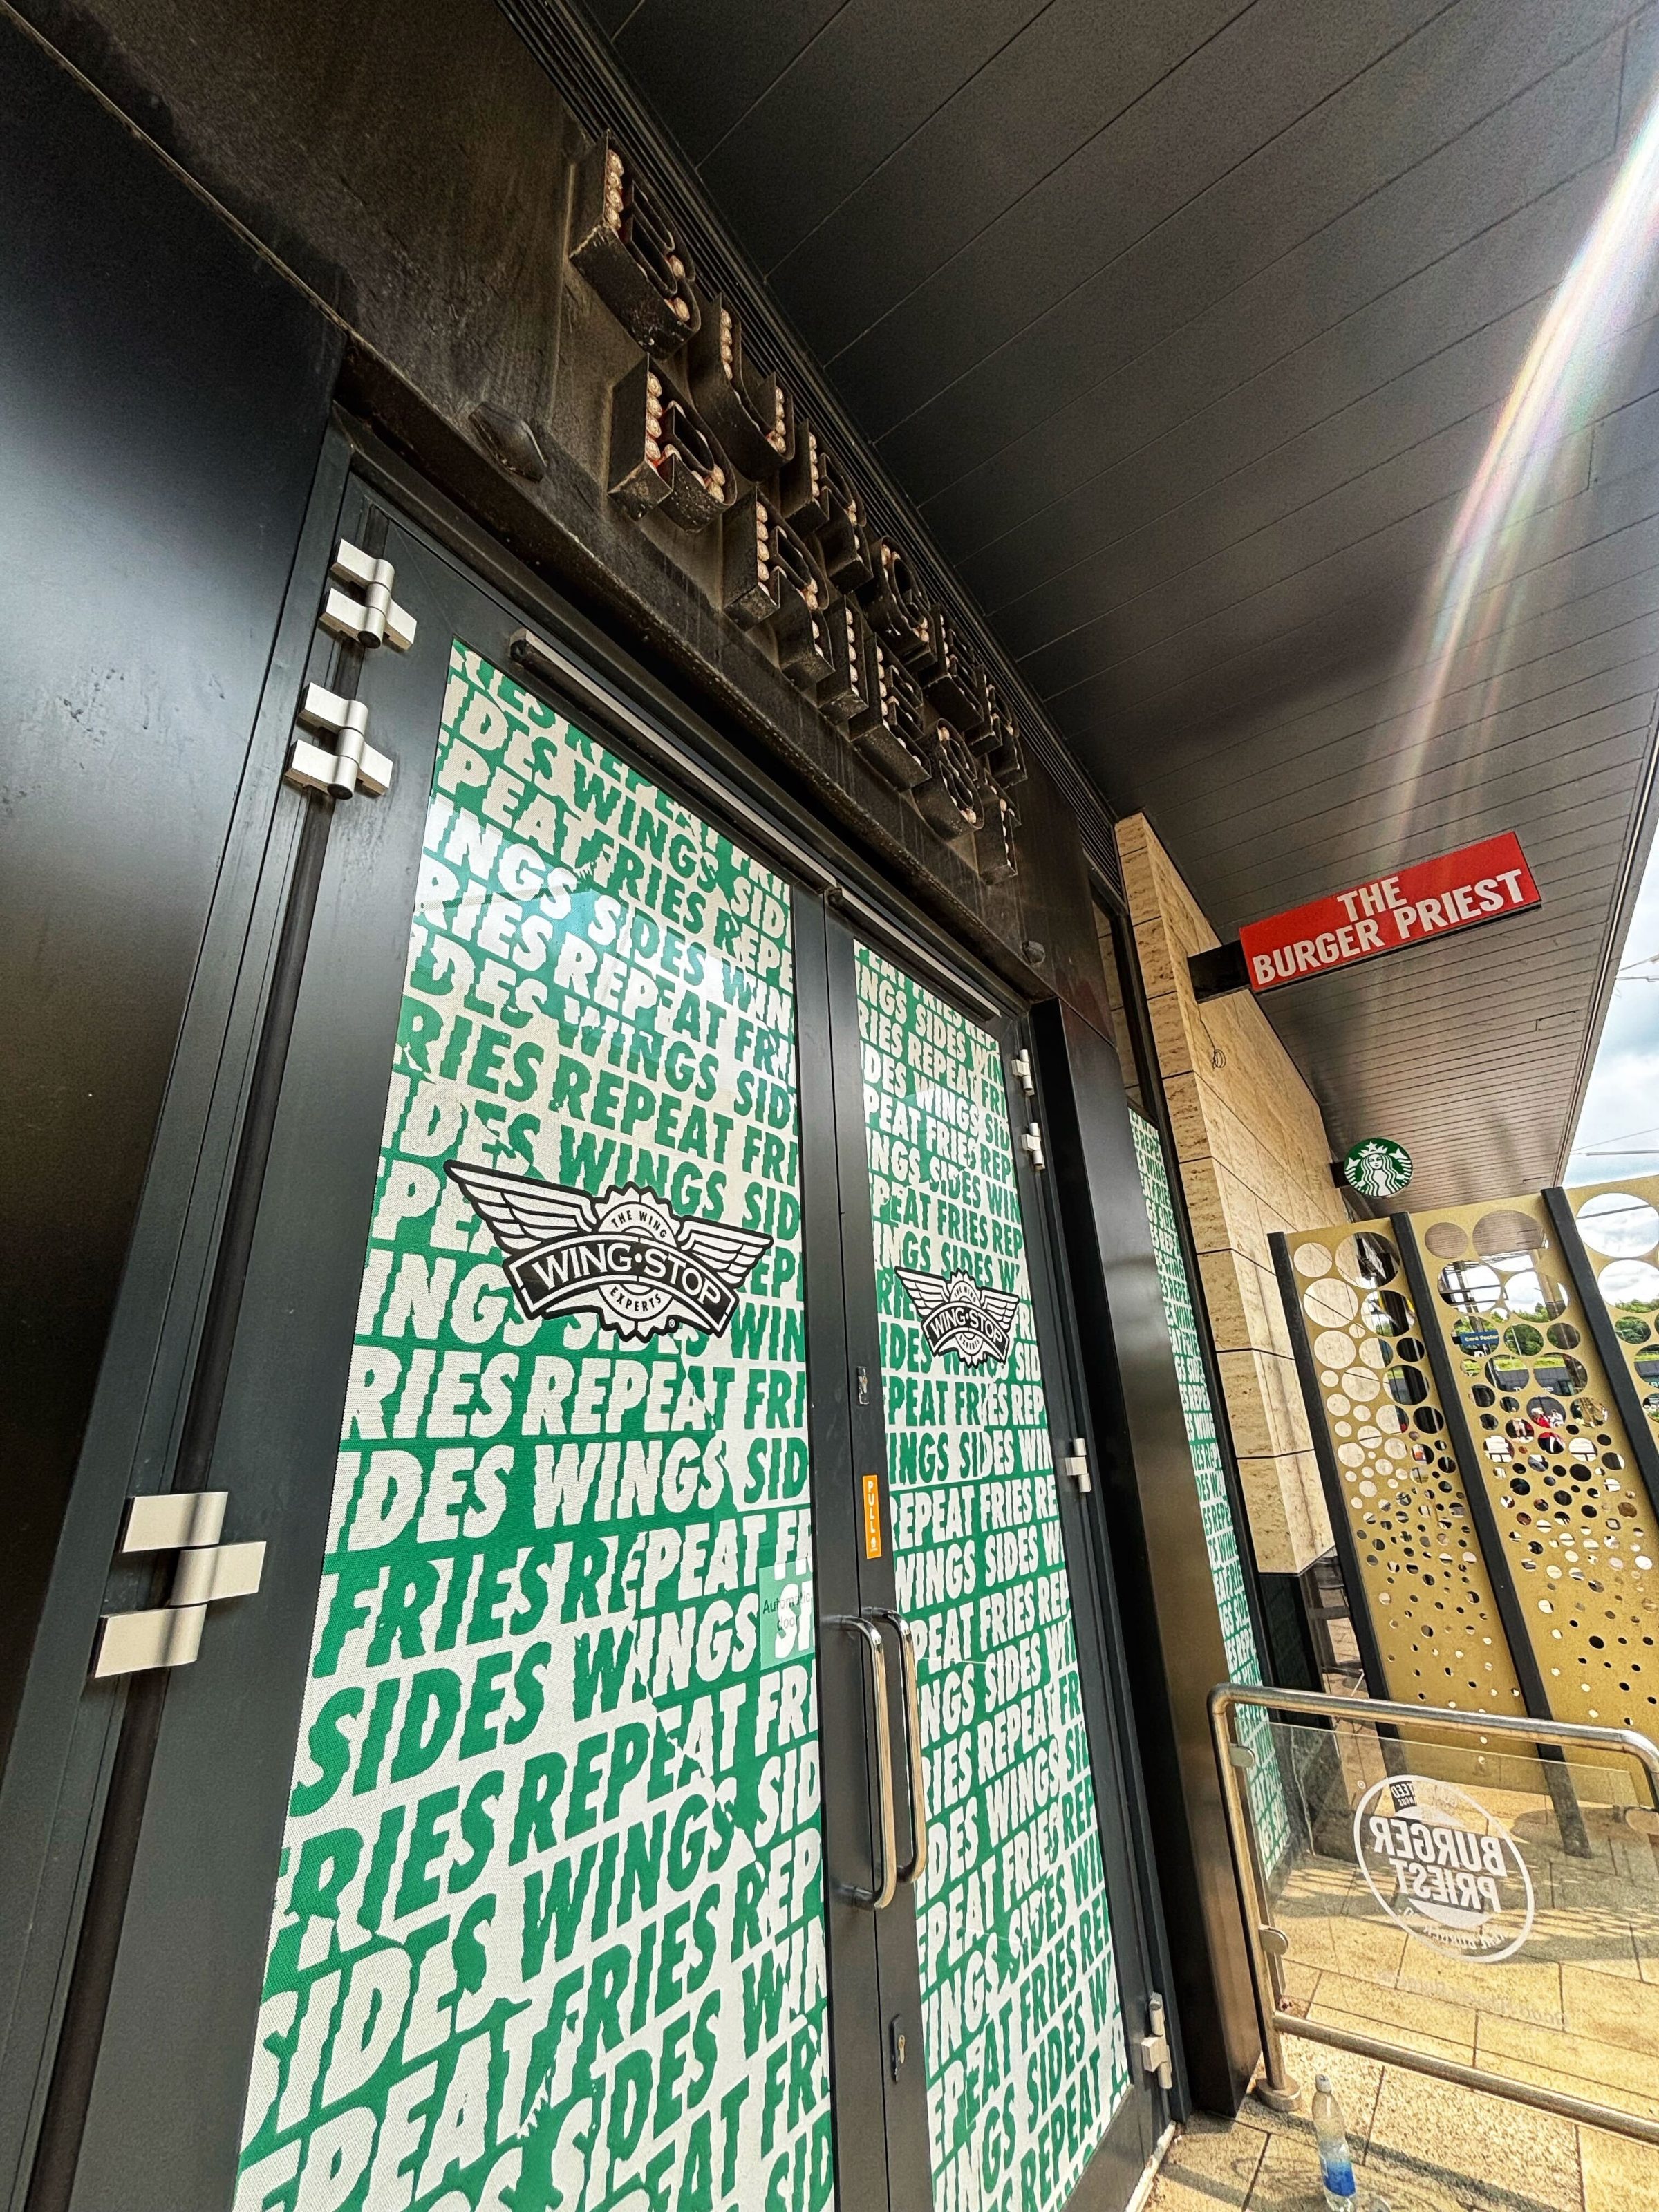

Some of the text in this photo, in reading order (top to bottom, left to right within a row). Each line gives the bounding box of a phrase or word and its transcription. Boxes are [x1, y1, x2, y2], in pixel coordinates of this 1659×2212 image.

[1251, 868, 1525, 986] BURGER PRIEST
[1335, 875, 1408, 924] THE
[554, 931, 727, 1050] REPEAT
[550, 1053, 734, 1165] REPEAT
[611, 1210, 668, 1239] THE WING
[610, 1286, 662, 1313] EXPERTS
[521, 1355, 735, 1436] REPEAT
[882, 1375, 949, 1426] PEAT
[532, 1438, 728, 1530] WINGS
[742, 1436, 808, 1506] SID
[867, 1480, 877, 1533] PULL
[980, 1479, 1033, 1533] FRIES
[312, 1547, 554, 1680] FRIES
[559, 1514, 769, 1627] REPEAT
[984, 1525, 1039, 1588] SIDES
[980, 1580, 1035, 1652] FRIES
[288, 1640, 553, 1819] SIDES
[572, 1593, 760, 1723] WINGS
[984, 1632, 1042, 1713] SIDES
[279, 1769, 506, 1970] RIES
[509, 1682, 748, 1867] REPEAT
[518, 1794, 737, 1984] WINGS
